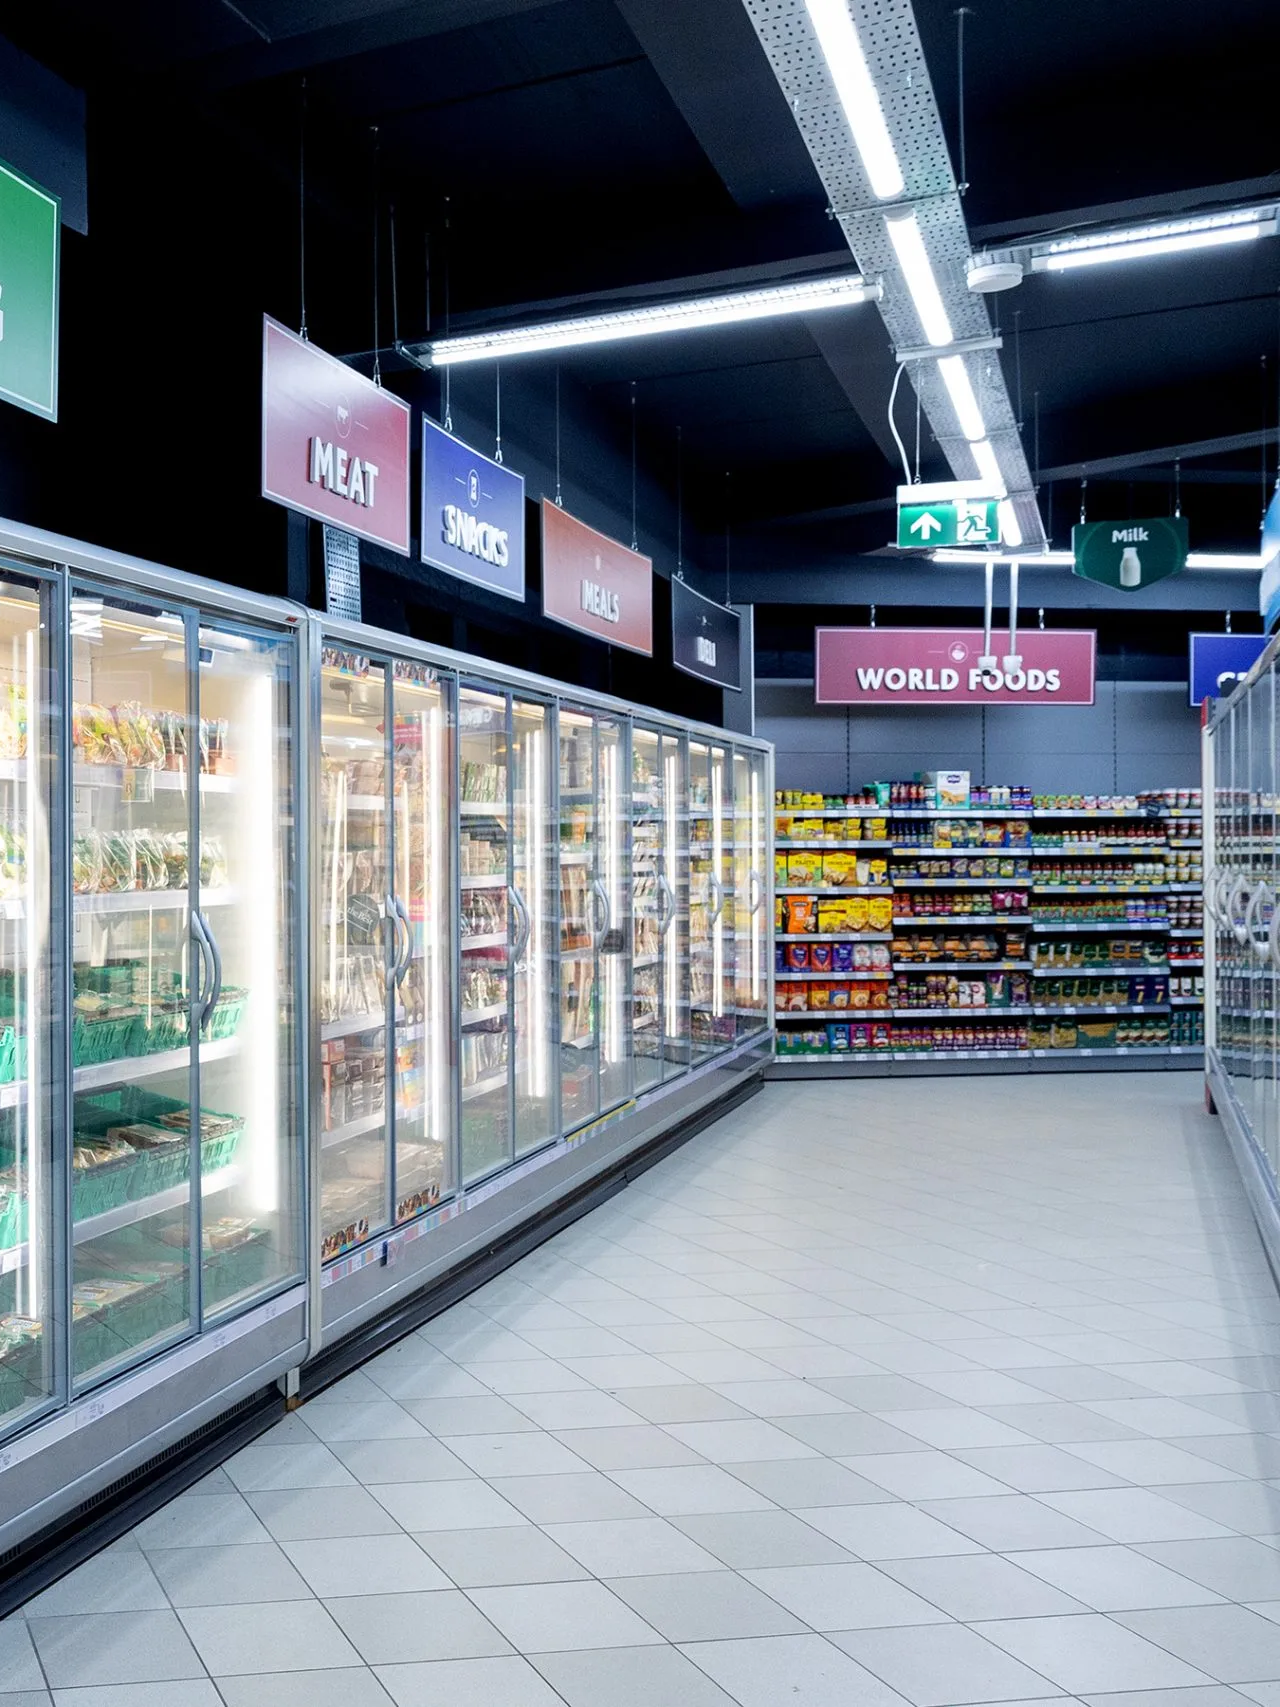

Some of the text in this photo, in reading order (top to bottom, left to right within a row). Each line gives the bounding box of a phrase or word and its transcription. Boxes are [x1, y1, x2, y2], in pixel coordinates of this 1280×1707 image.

[310, 436, 379, 508] MEAT
[442, 505, 509, 567] SNACKS
[1112, 527, 1149, 543] Milk
[581, 580, 619, 624] MEALS
[856, 667, 1061, 693] WORLD FOODS
